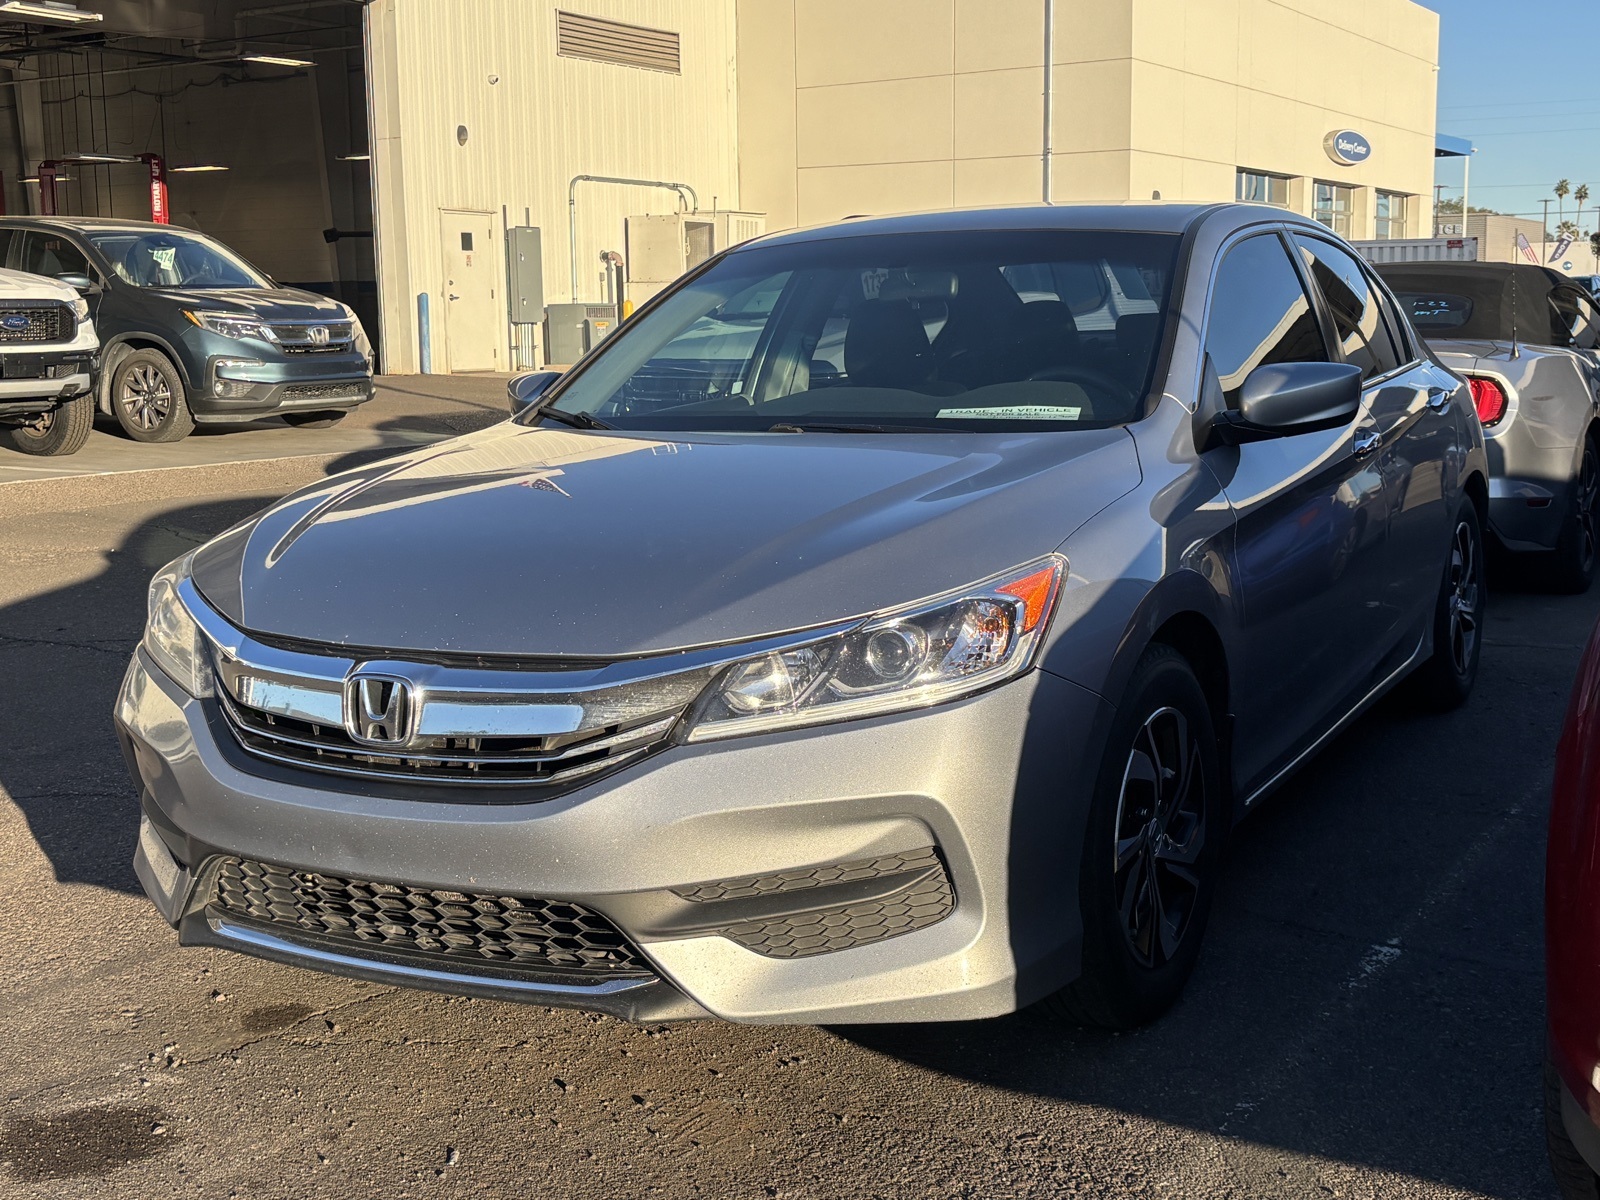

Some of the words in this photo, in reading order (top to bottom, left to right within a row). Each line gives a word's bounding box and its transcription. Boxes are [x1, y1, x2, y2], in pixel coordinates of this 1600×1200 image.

[1338, 138, 1354, 154] Delivery
[151, 159, 160, 177] LIFT
[152, 179, 162, 212] ROTARY
[154, 251, 173, 263] 4474
